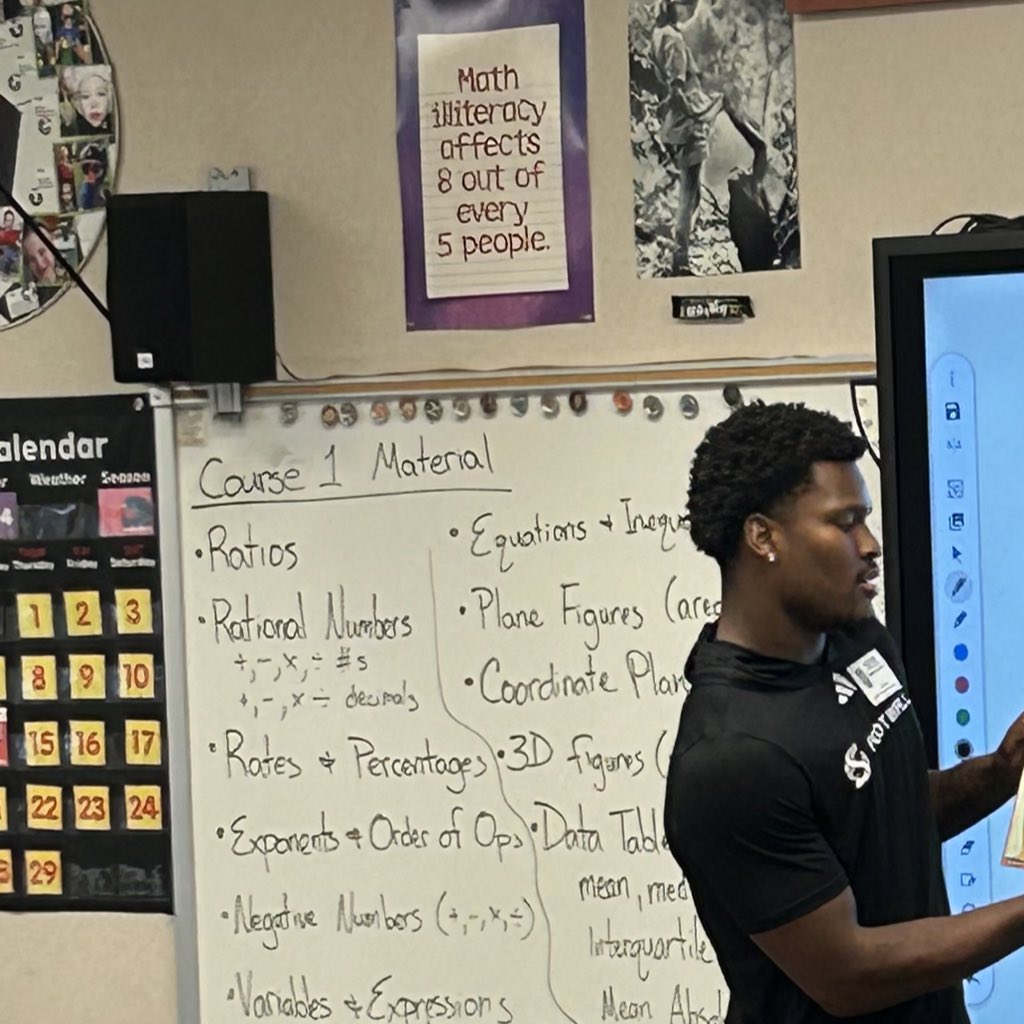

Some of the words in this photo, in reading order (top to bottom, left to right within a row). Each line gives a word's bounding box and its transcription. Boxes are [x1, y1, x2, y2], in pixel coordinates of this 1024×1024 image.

[457, 64, 520, 93] Math
[432, 98, 548, 128] illiteracy
[440, 129, 542, 161] affects
[437, 166, 453, 194] 8
[461, 164, 506, 192] out
[515, 160, 546, 189] of
[456, 200, 529, 227] every
[437, 231, 453, 258] 5
[462, 225, 551, 263] people.
[199, 457, 305, 499] Course
[319, 444, 342, 488] 1
[371, 432, 494, 481] Material
[207, 522, 298, 572] Ratios
[470, 512, 588, 573] Equations
[29, 603, 40, 629] 1
[75, 600, 92, 626] 2
[126, 598, 142, 625] 3
[211, 590, 307, 643] Rational
[325, 584, 413, 640] Numbers
[471, 586, 544, 629] Plane
[560, 582, 644, 651] Figures
[31, 664, 47, 691] 8
[79, 663, 95, 690] 9
[122, 662, 150, 690] 10
[479, 654, 618, 706] Coordinate
[28, 730, 55, 756] 15
[75, 730, 102, 757] 16
[131, 729, 155, 757] 17
[225, 729, 303, 779] Rates
[347, 736, 488, 794] Percentages
[506, 730, 554, 771] 3D
[31, 794, 59, 821] 22
[78, 795, 106, 821] 23
[128, 794, 160, 821] 24
[533, 800, 604, 852] Data
[230, 811, 340, 873] Exponents
[369, 813, 430, 851] Order
[438, 805, 464, 849] of
[474, 811, 524, 863] Ops
[29, 859, 58, 885] 29
[233, 892, 319, 950] Negative
[336, 890, 423, 934] Numbers
[588, 914, 714, 981] Interquartile
[235, 970, 333, 1020] Variables
[601, 985, 653, 1022] Mean
